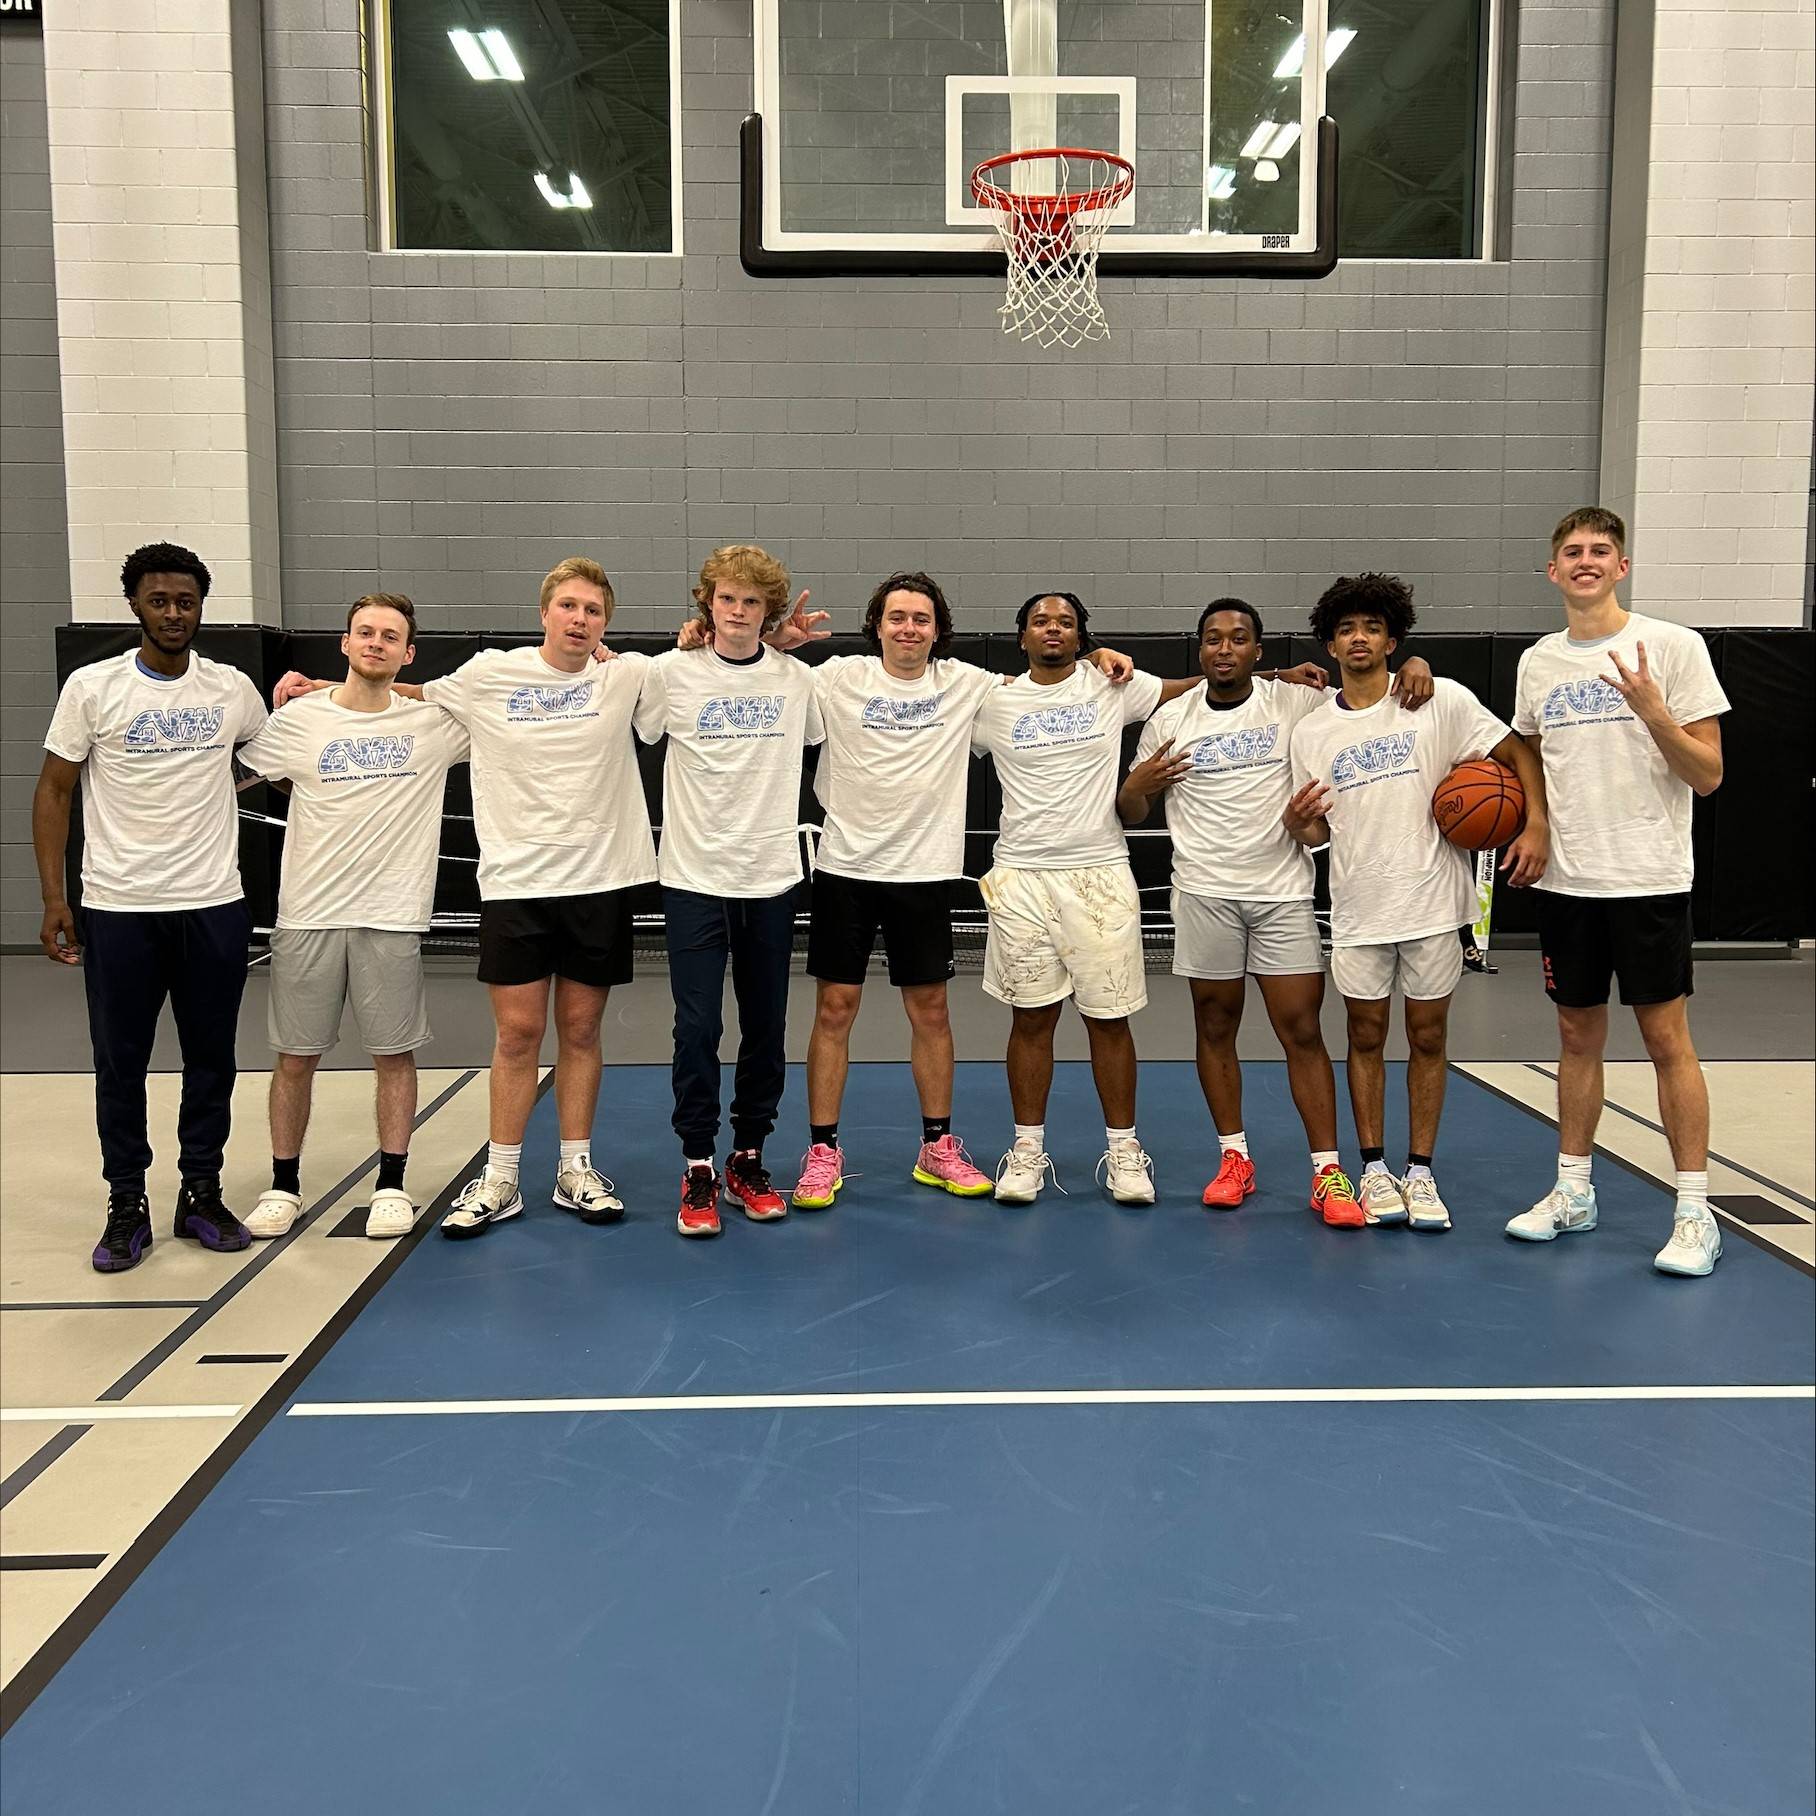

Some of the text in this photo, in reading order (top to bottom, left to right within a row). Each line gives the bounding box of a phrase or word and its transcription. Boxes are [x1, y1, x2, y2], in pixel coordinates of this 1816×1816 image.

[1578, 717, 1602, 725] SPORTS
[920, 722, 944, 730] CHAMPION
[1014, 742, 1051, 750] INTRAMURAL
[1076, 732, 1106, 742] CHAMPION
[1254, 758, 1283, 767] CHAMPION
[321, 775, 361, 783] INTRAMURAL
[1370, 773, 1390, 783] SPORTS
[1390, 768, 1420, 778] CHAMPION
[1484, 849, 1494, 882] HAMPION
